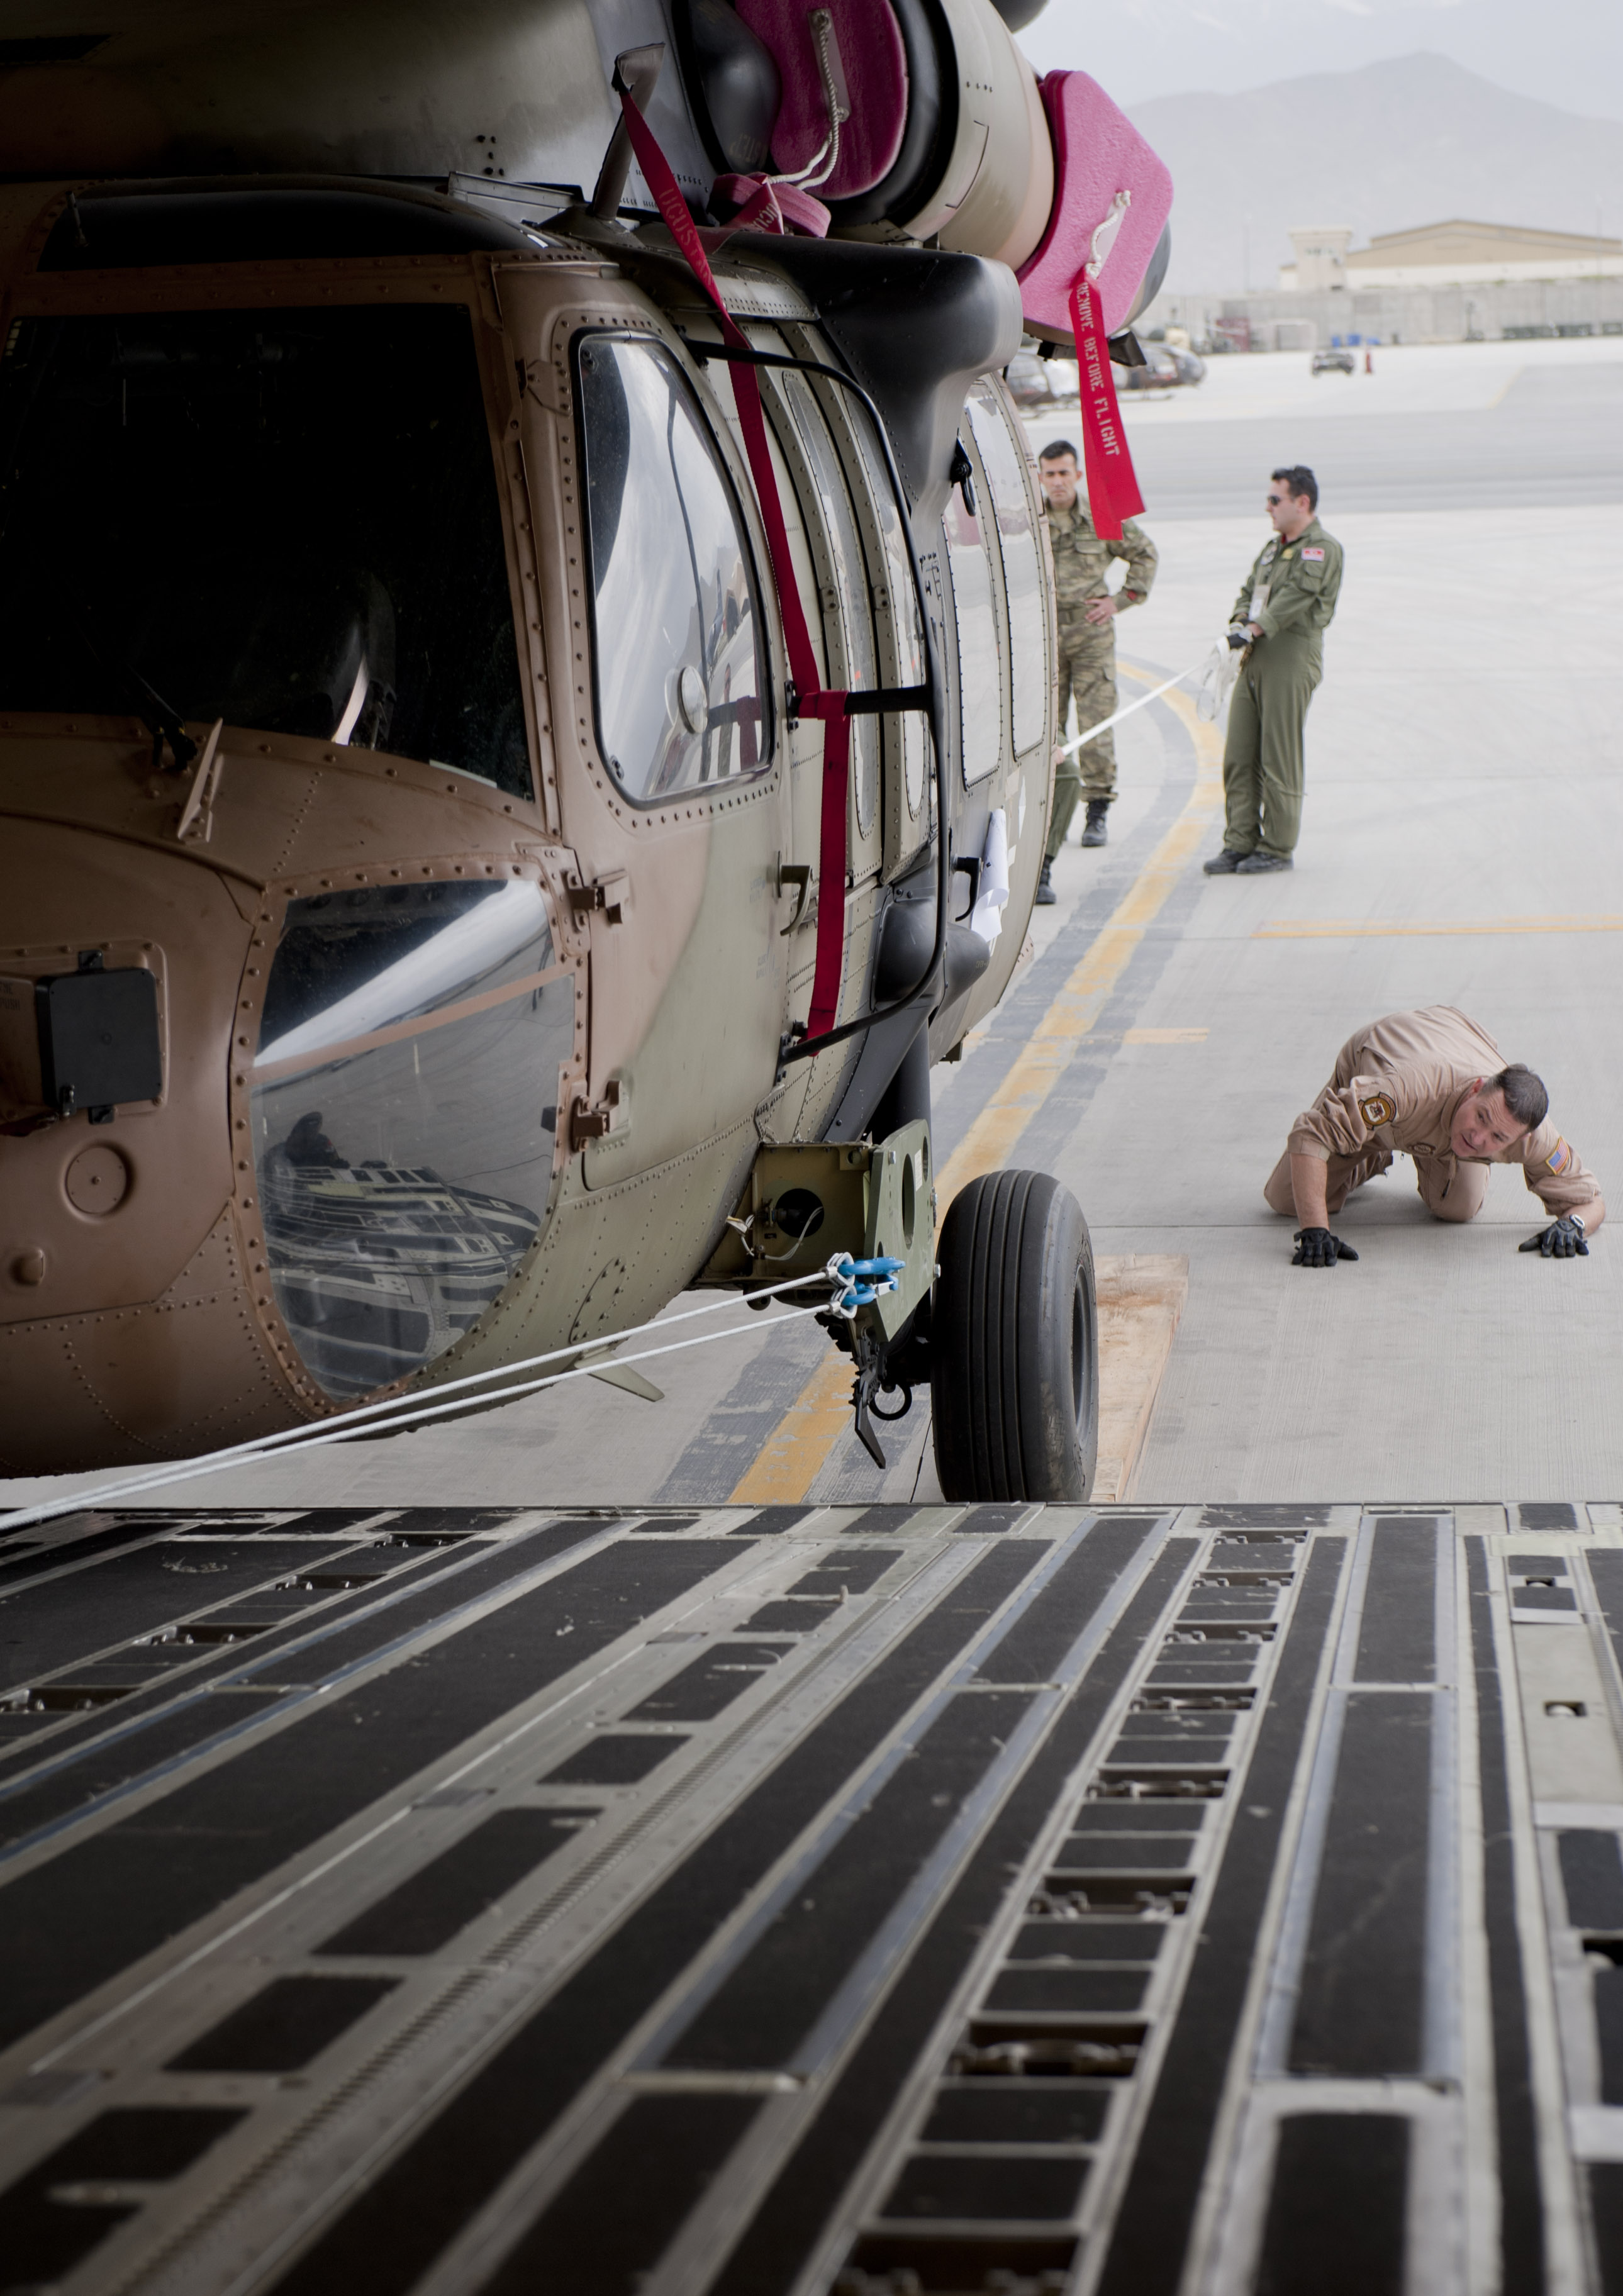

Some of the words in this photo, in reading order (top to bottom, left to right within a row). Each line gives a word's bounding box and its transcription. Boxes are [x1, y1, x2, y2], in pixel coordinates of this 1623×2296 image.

[1076, 282, 1095, 333] REMOVE
[1083, 337, 1105, 392] BEFORE
[1094, 397, 1120, 456] FLIGHT
